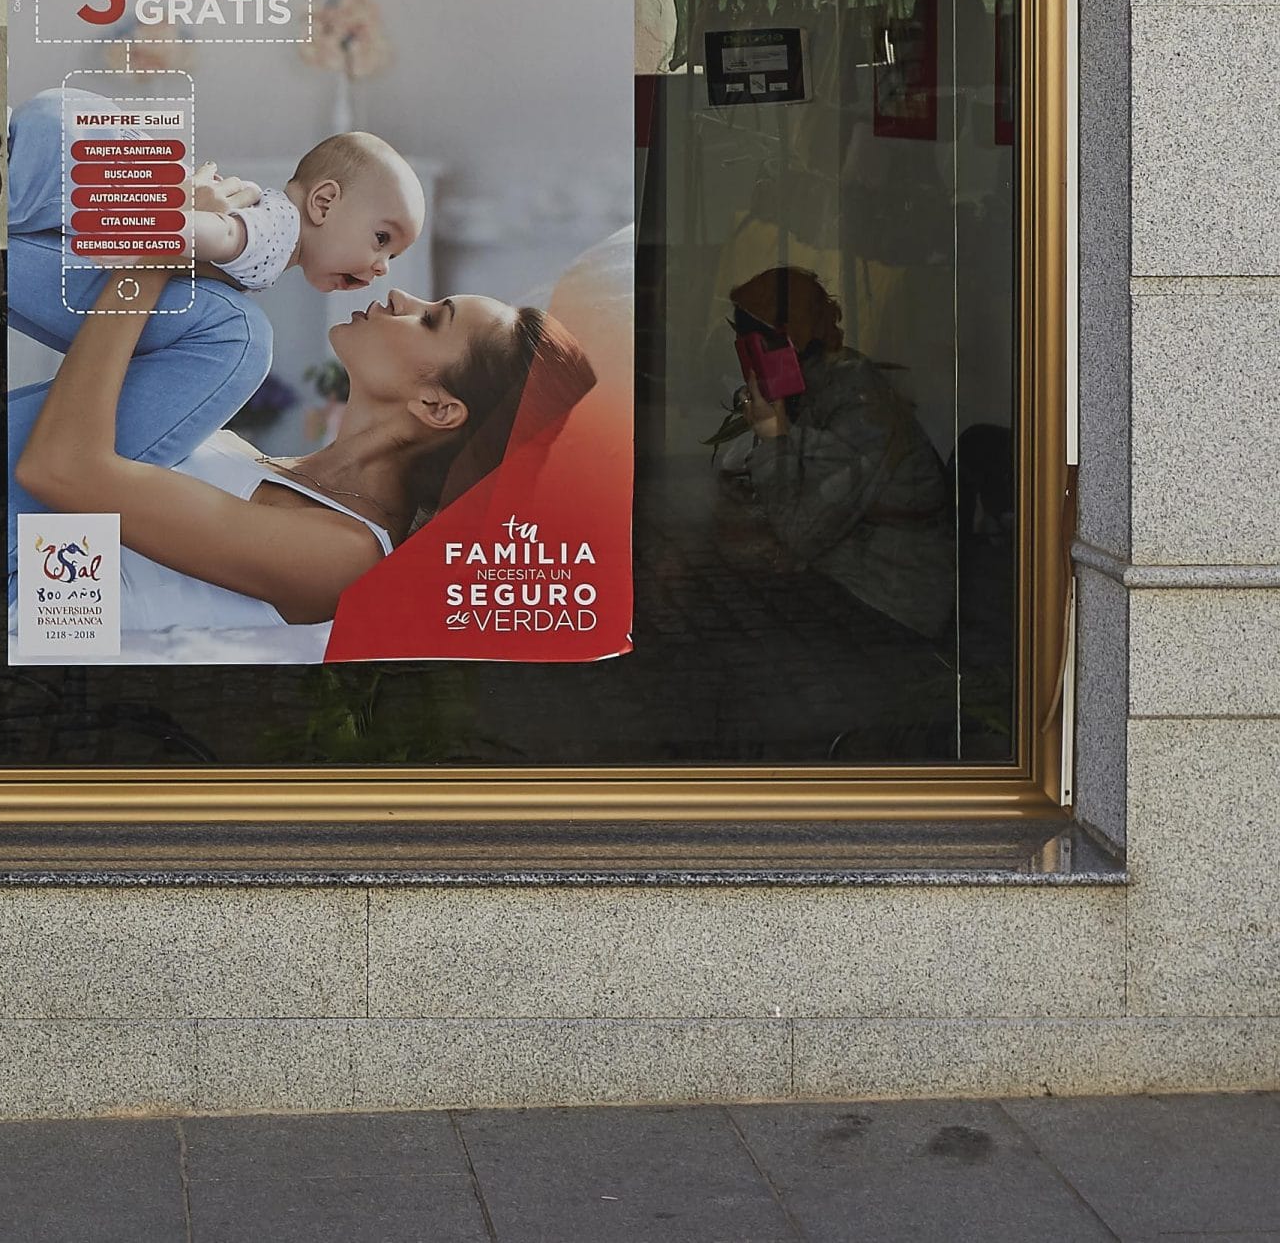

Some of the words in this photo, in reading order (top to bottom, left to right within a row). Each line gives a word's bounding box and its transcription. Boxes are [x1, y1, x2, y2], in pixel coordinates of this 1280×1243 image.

[76, 115, 140, 125] MAPFRE
[144, 114, 180, 125] Salud
[84, 146, 122, 156] TARJETA
[123, 146, 172, 155] SANITARIA
[104, 170, 153, 179] BUSCADOR
[89, 193, 168, 202] AUTORIZACIONES
[101, 217, 121, 226] CITA
[122, 217, 156, 226] ONLINE
[76, 240, 131, 250] REEMBOLSO
[132, 240, 144, 249] DE
[145, 240, 181, 250] GASTOS
[502, 514, 538, 543] tu
[445, 542, 596, 565] FAMILIA
[477, 569, 546, 581] NECESITA
[550, 569, 571, 581] UN
[37, 587, 61, 603] 800
[446, 584, 597, 606] SEGURO
[446, 610, 471, 627] de
[472, 609, 597, 631] VERDAD
[46, 630, 66, 639] 1218
[74, 630, 96, 639] 2018
